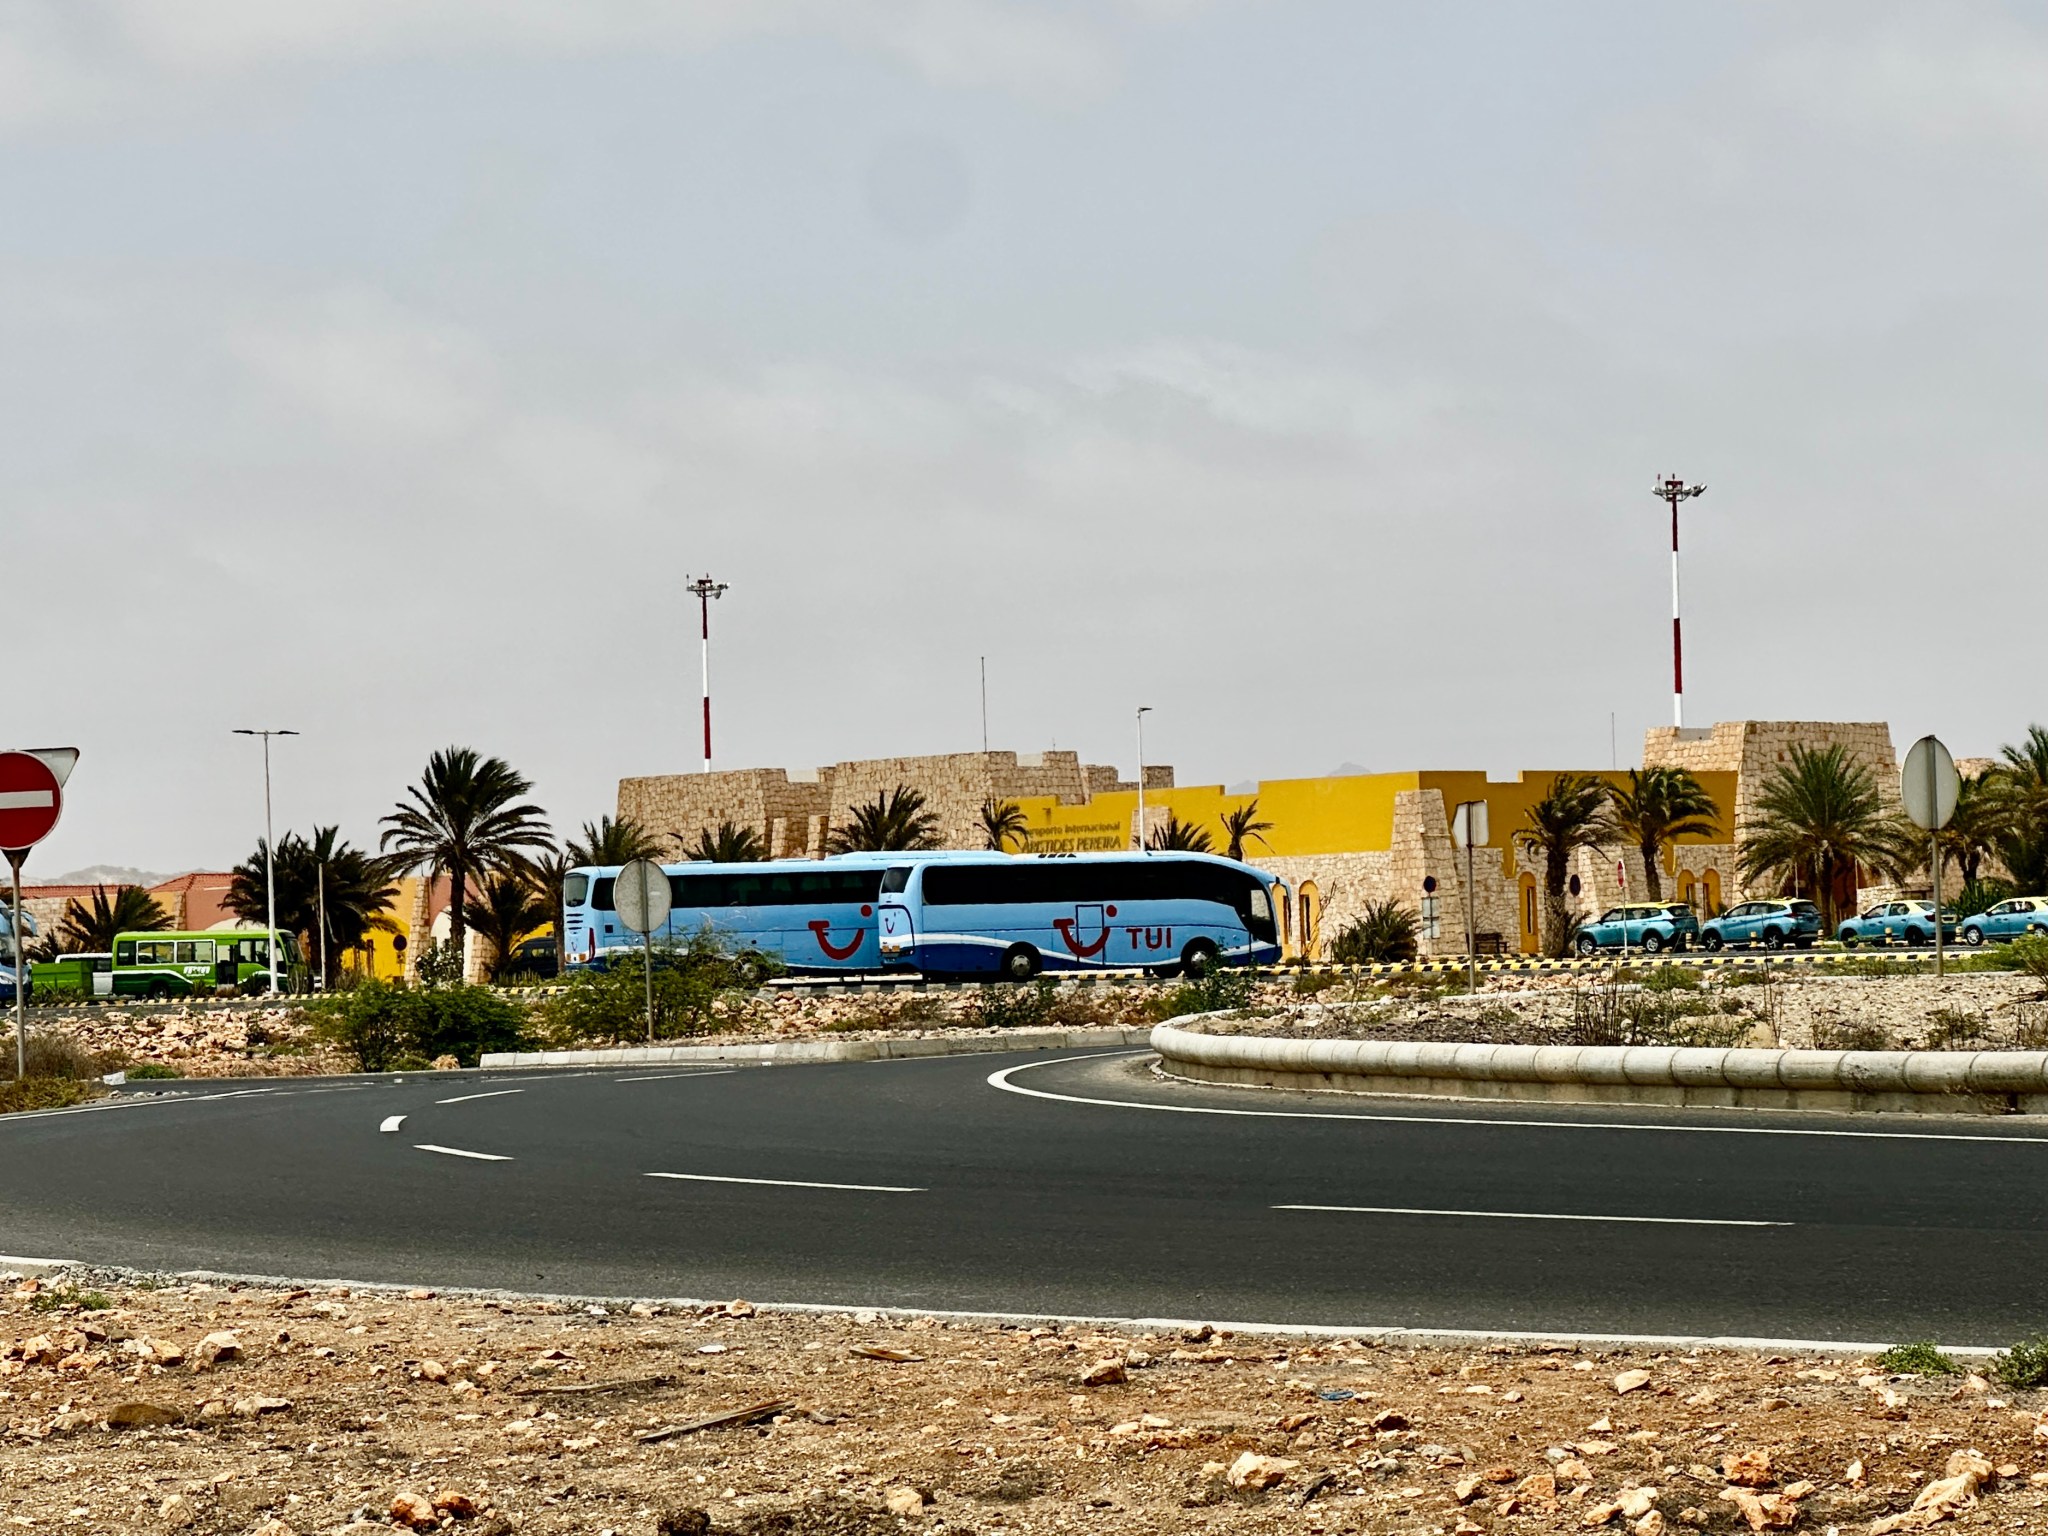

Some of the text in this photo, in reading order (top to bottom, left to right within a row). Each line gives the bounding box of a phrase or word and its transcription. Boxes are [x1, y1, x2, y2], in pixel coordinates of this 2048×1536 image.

[1065, 821, 1120, 834] Internacional
[1077, 835, 1121, 851] PEREIRA
[1126, 927, 1172, 950] TUI
